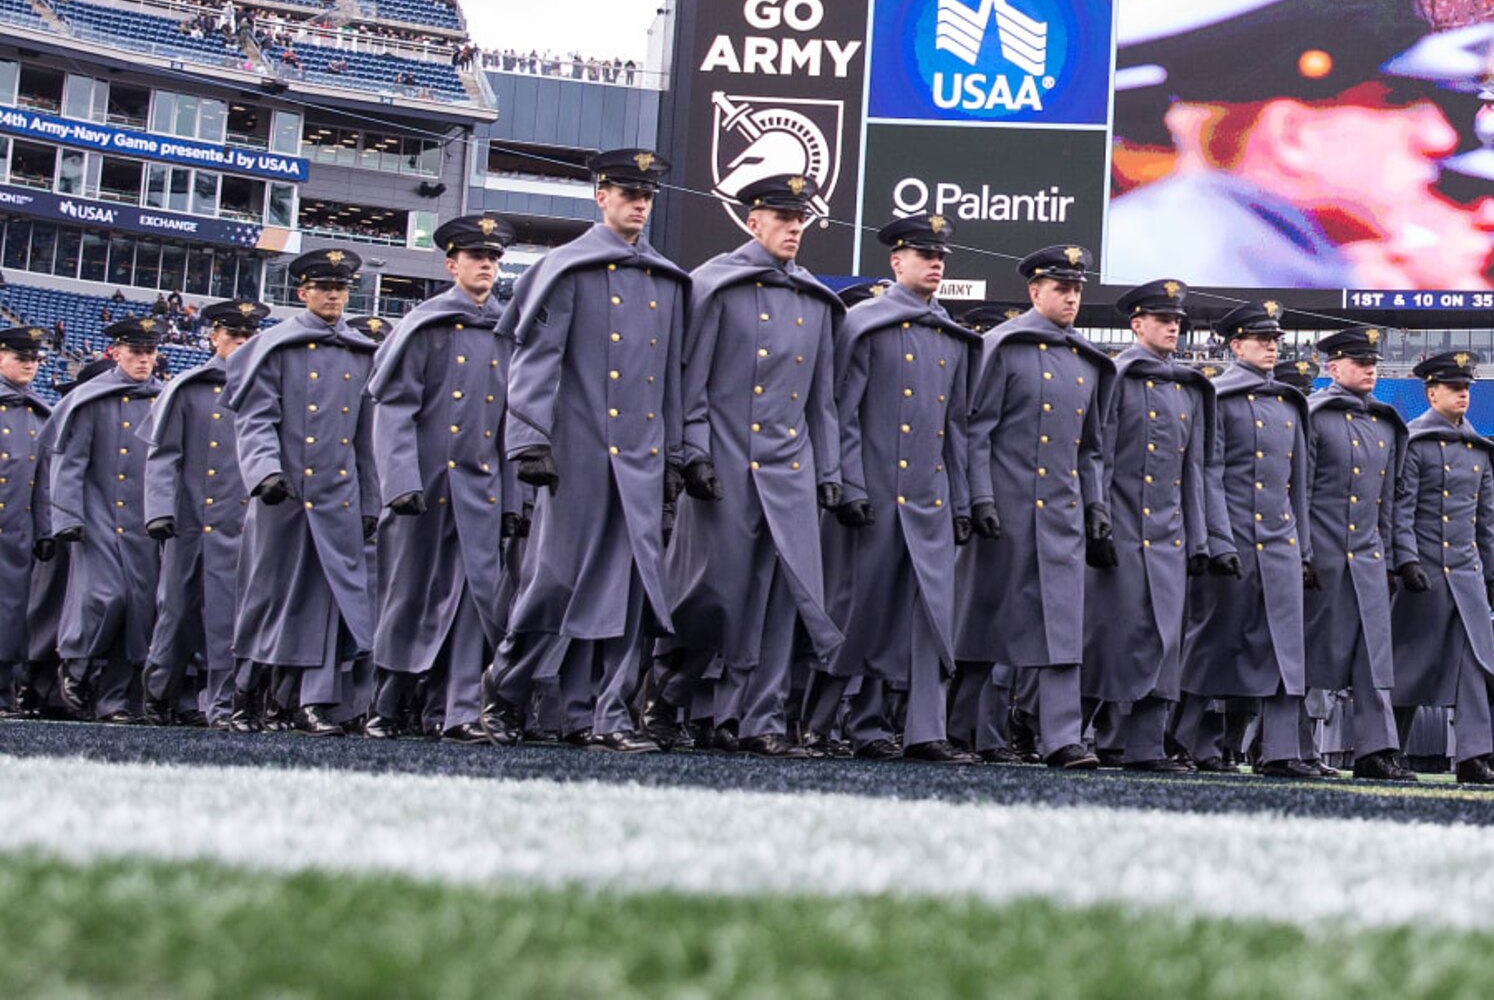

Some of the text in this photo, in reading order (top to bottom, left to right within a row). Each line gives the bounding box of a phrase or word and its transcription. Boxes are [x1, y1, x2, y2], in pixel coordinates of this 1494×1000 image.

[700, 34, 862, 78] ARMY
[29, 117, 111, 146] Army-Navy
[114, 133, 158, 152] Game
[160, 142, 234, 164] presented
[237, 152, 257, 169] by
[258, 157, 300, 175] USAA
[936, 183, 1074, 223] Palantir
[78, 205, 114, 223] USAA
[139, 215, 199, 232] EXCHANGE
[939, 283, 973, 296] ARMY
[1351, 293, 1493, 308] 1ST & 10 ON 35
